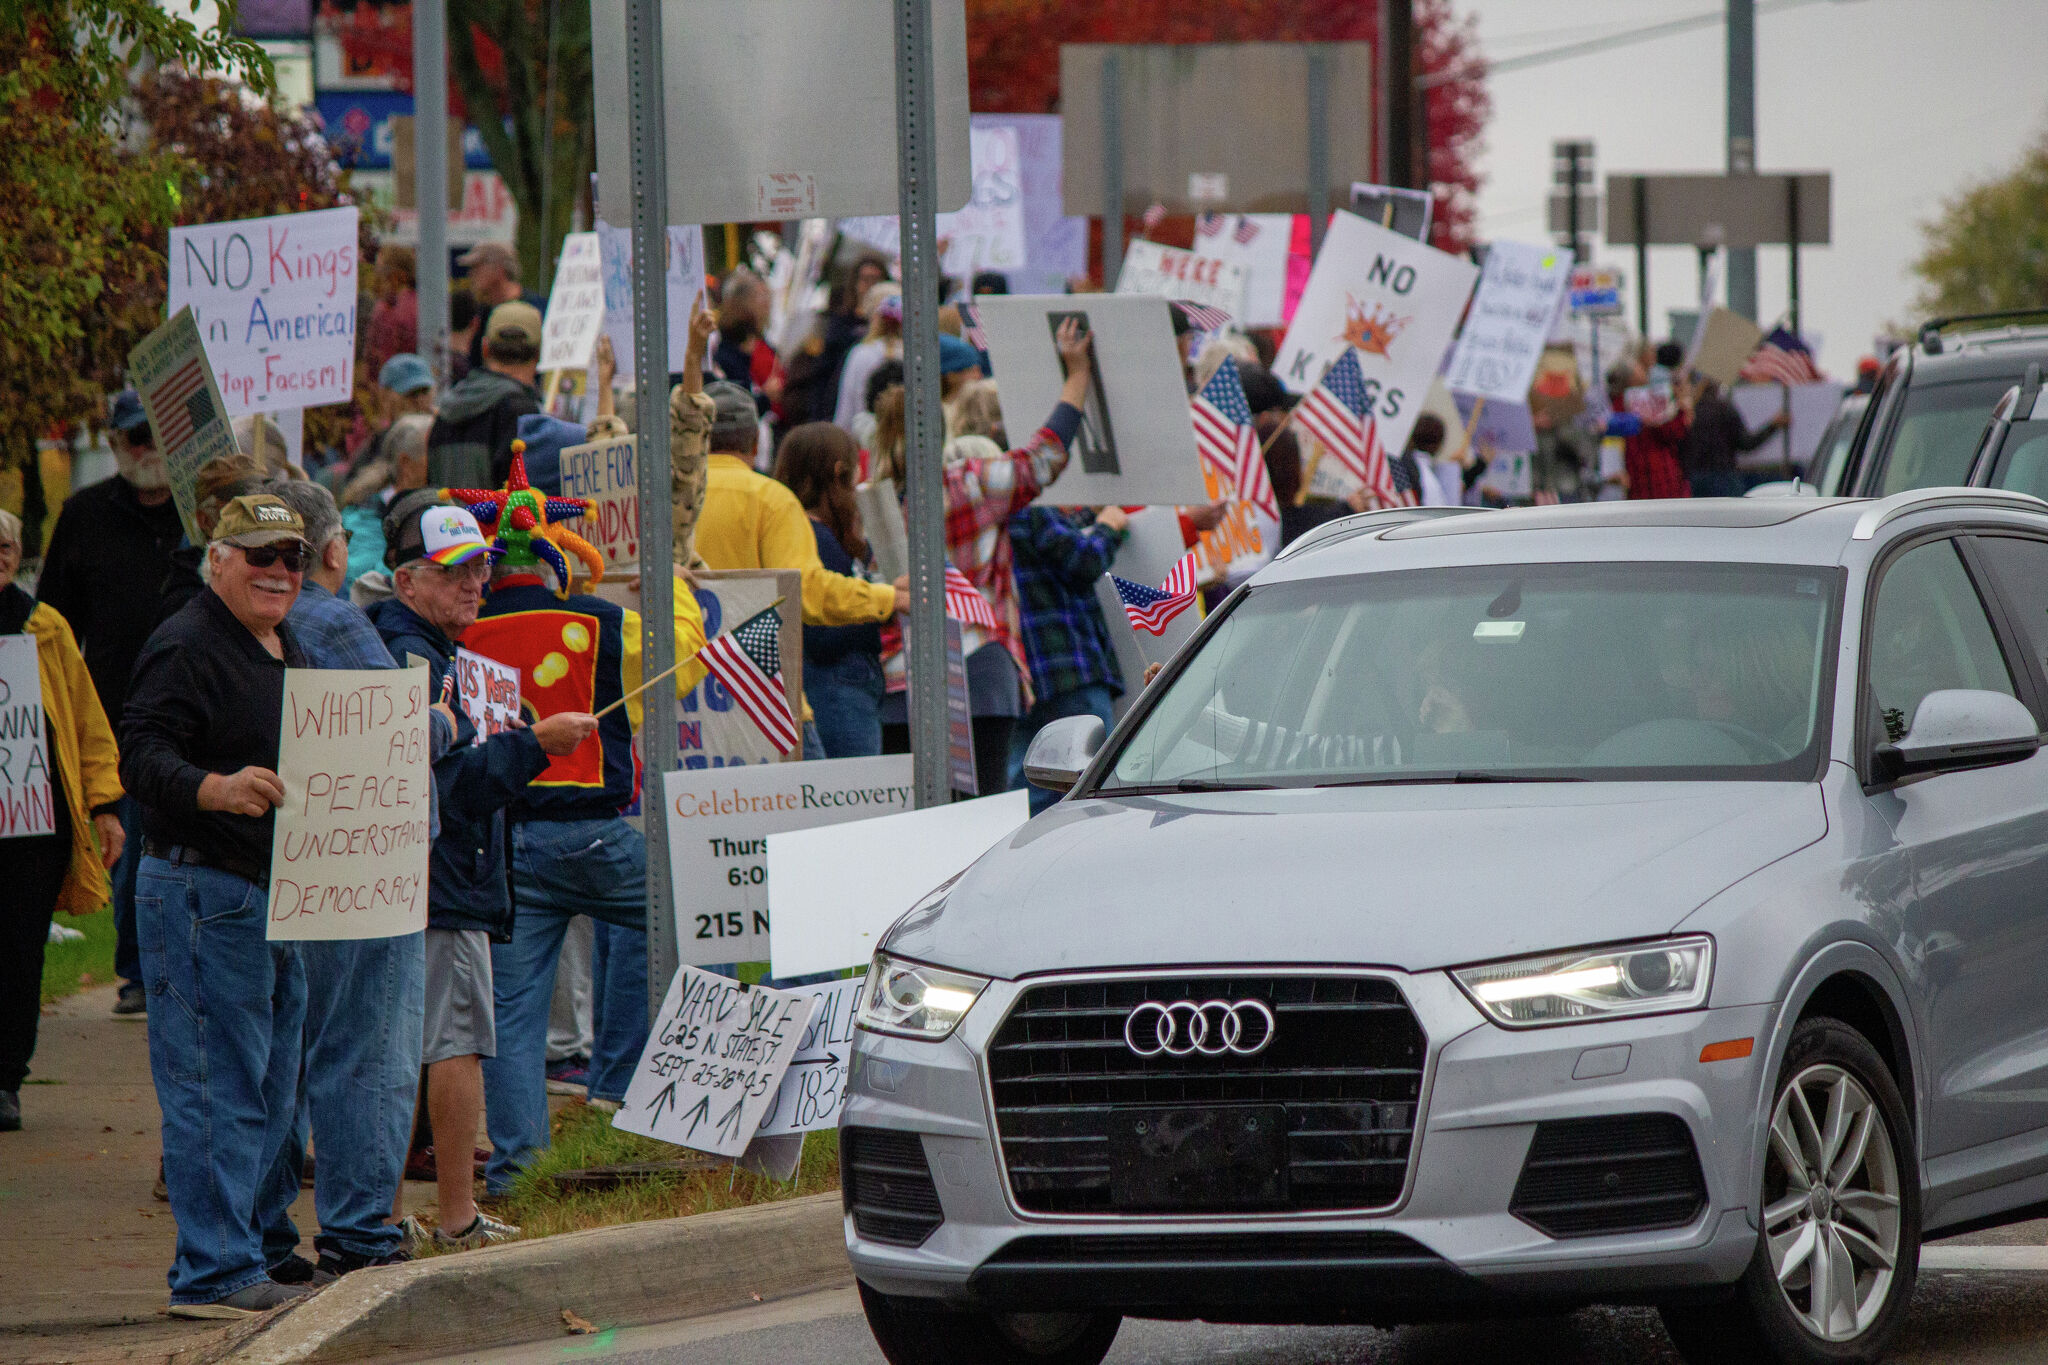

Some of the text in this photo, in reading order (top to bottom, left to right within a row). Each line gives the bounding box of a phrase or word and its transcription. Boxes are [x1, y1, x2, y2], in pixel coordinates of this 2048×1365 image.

[184, 225, 352, 298] NO Kings
[1366, 253, 1417, 296] NO
[245, 296, 355, 345] America!
[217, 355, 347, 407] top Facism!
[561, 443, 636, 498] HERE FOR
[289, 685, 393, 739] WHATS
[271, 872, 422, 922] DEMOCRACY
[727, 865, 768, 886] 6:0
[695, 911, 745, 939] 215
[675, 972, 802, 1039] YARD SALE
[659, 1020, 701, 1050] 625
[650, 1052, 695, 1084] SEPT.
